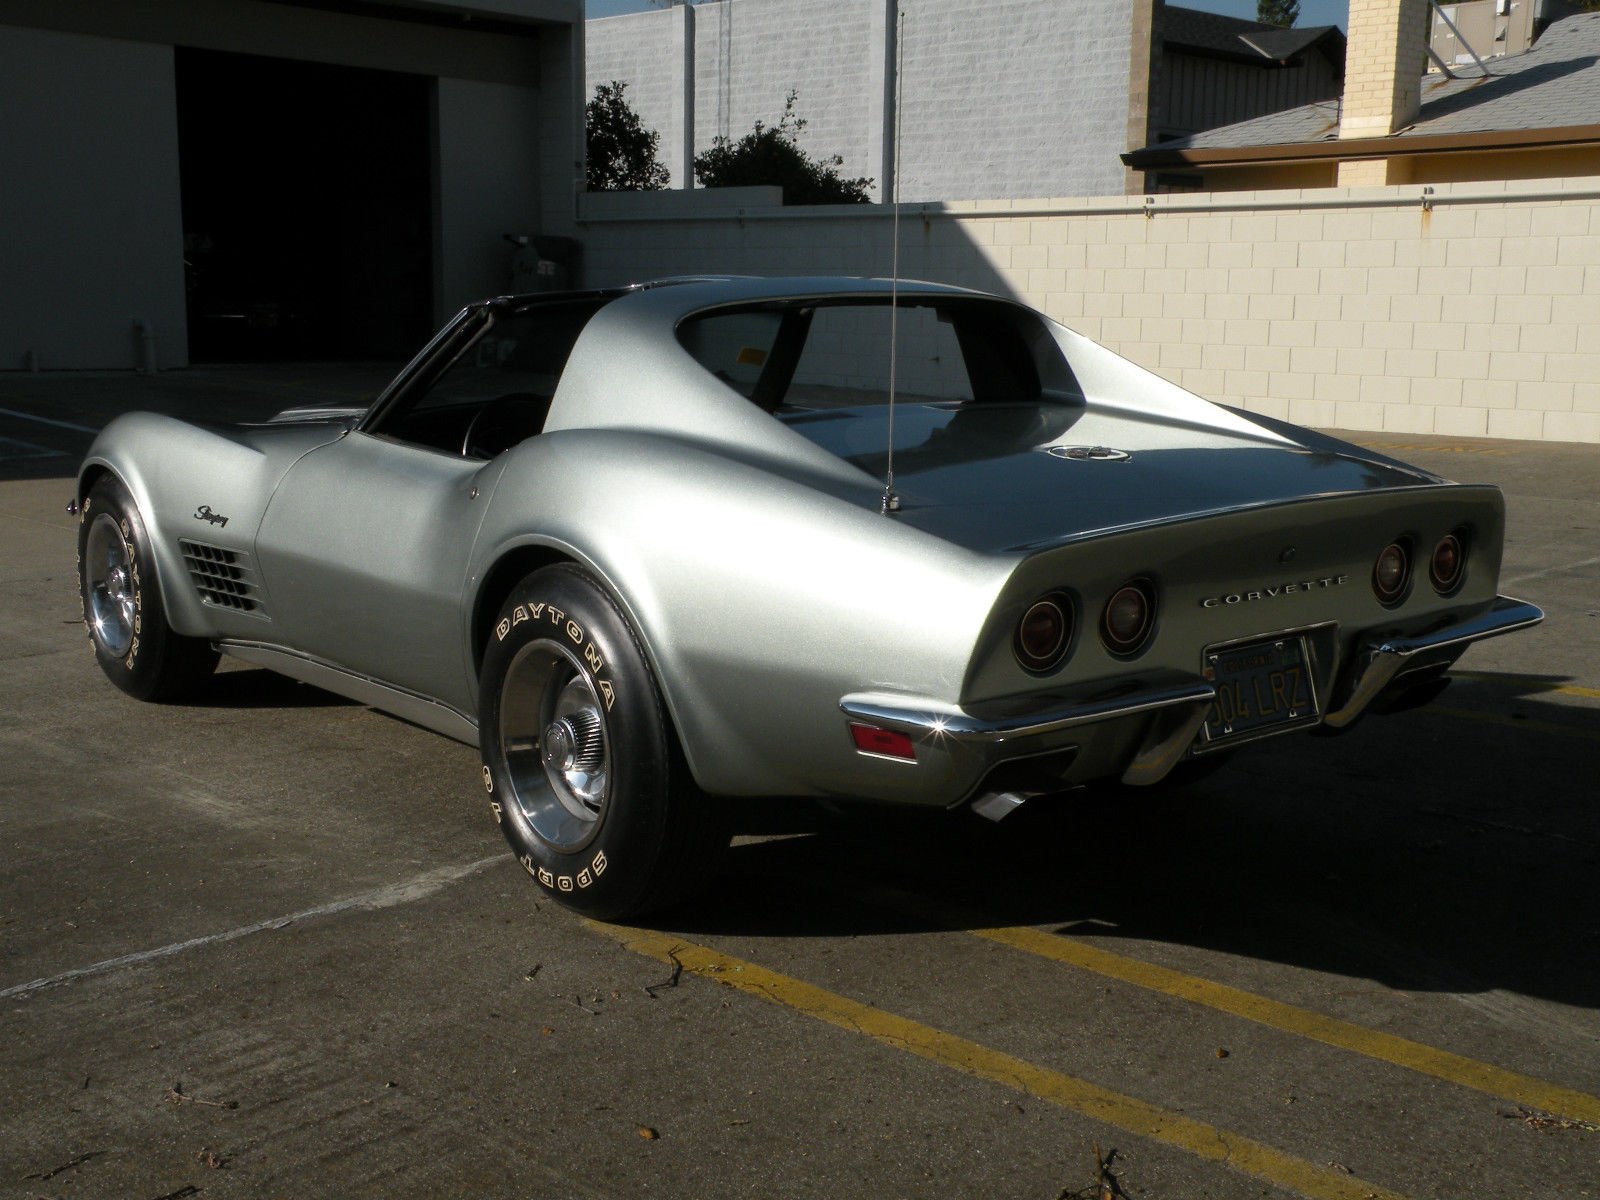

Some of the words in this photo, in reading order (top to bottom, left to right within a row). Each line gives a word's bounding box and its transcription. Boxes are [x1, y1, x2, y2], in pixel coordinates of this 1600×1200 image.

[1202, 575, 1349, 608] CORVETTE
[496, 603, 616, 712] DAYTONA
[1253, 666, 1307, 717] LRZ
[520, 850, 608, 893] SPORT
